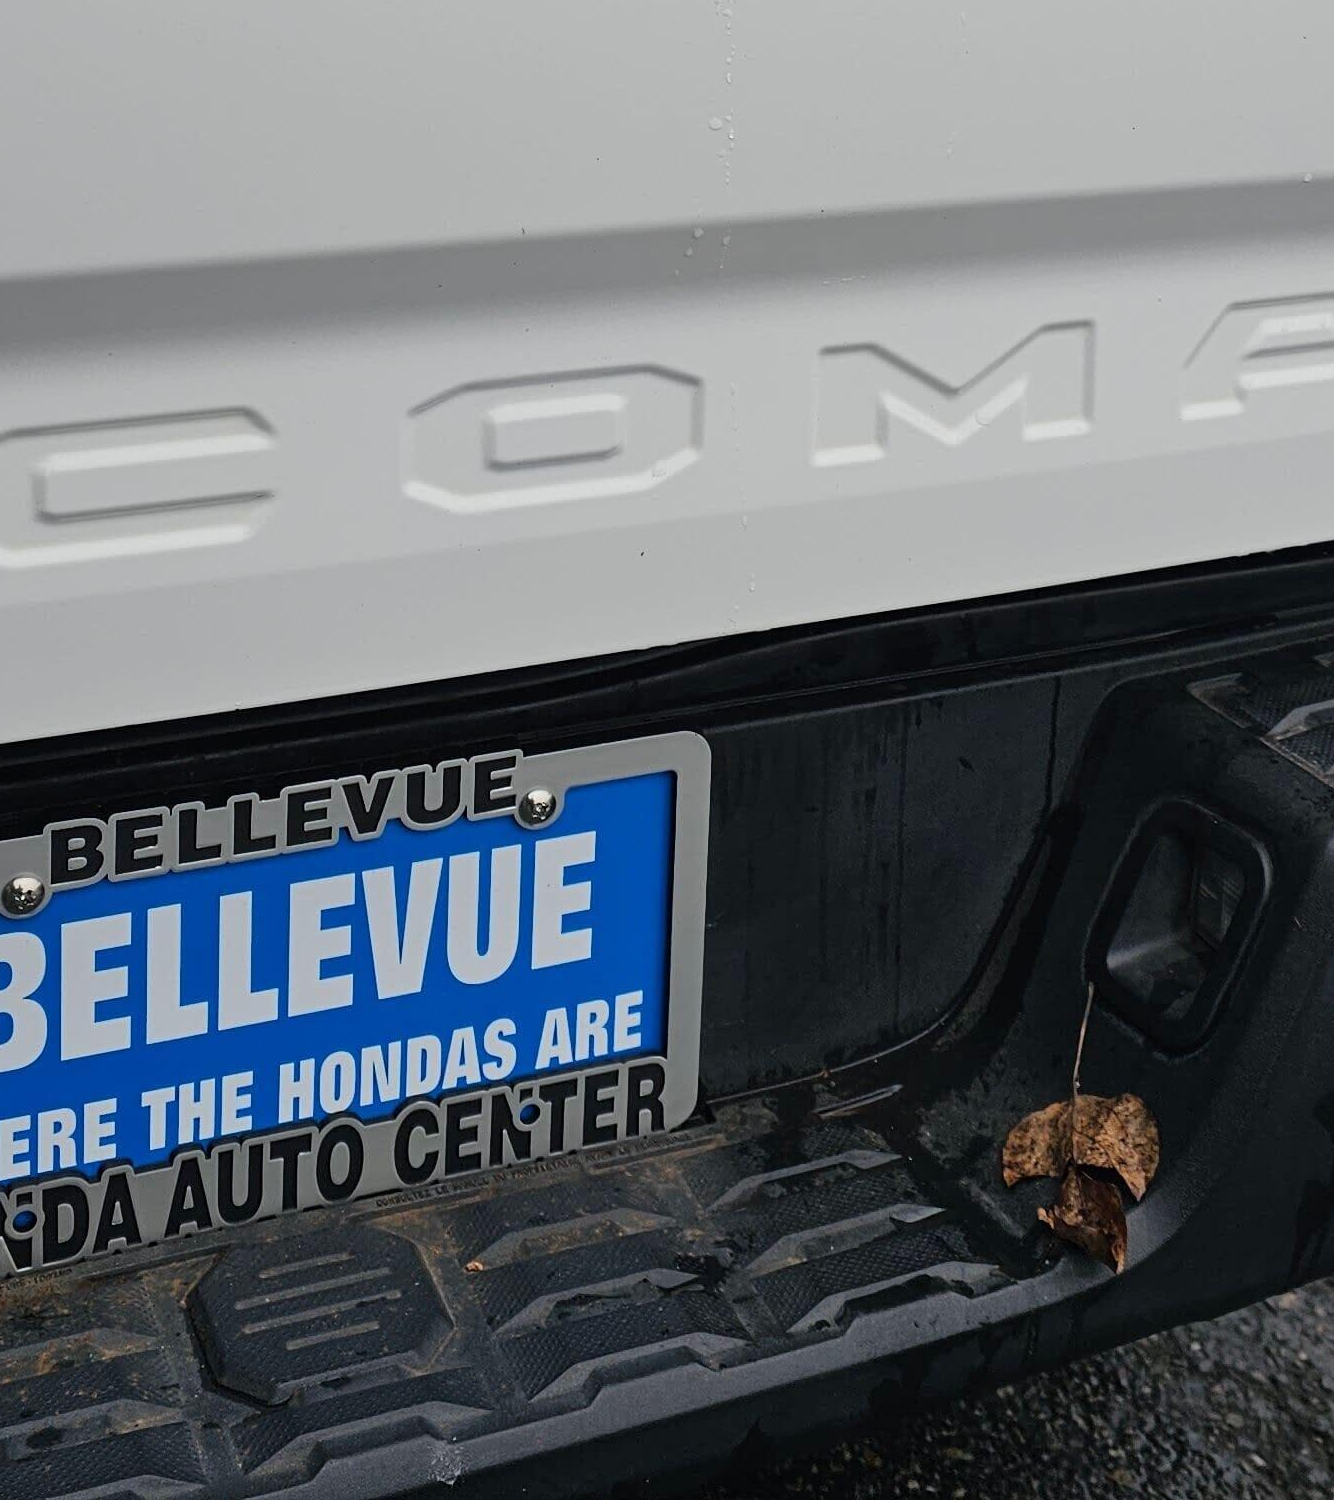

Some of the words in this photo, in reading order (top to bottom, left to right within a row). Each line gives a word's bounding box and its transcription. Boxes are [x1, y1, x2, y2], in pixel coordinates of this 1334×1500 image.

[50, 755, 517, 885] BELLEVUE
[141, 1070, 254, 1151] THE
[278, 1018, 517, 1124] HONDAS
[534, 990, 644, 1070] ARE
[163, 1123, 365, 1239] AUTO
[393, 1062, 666, 1186] CENTER
